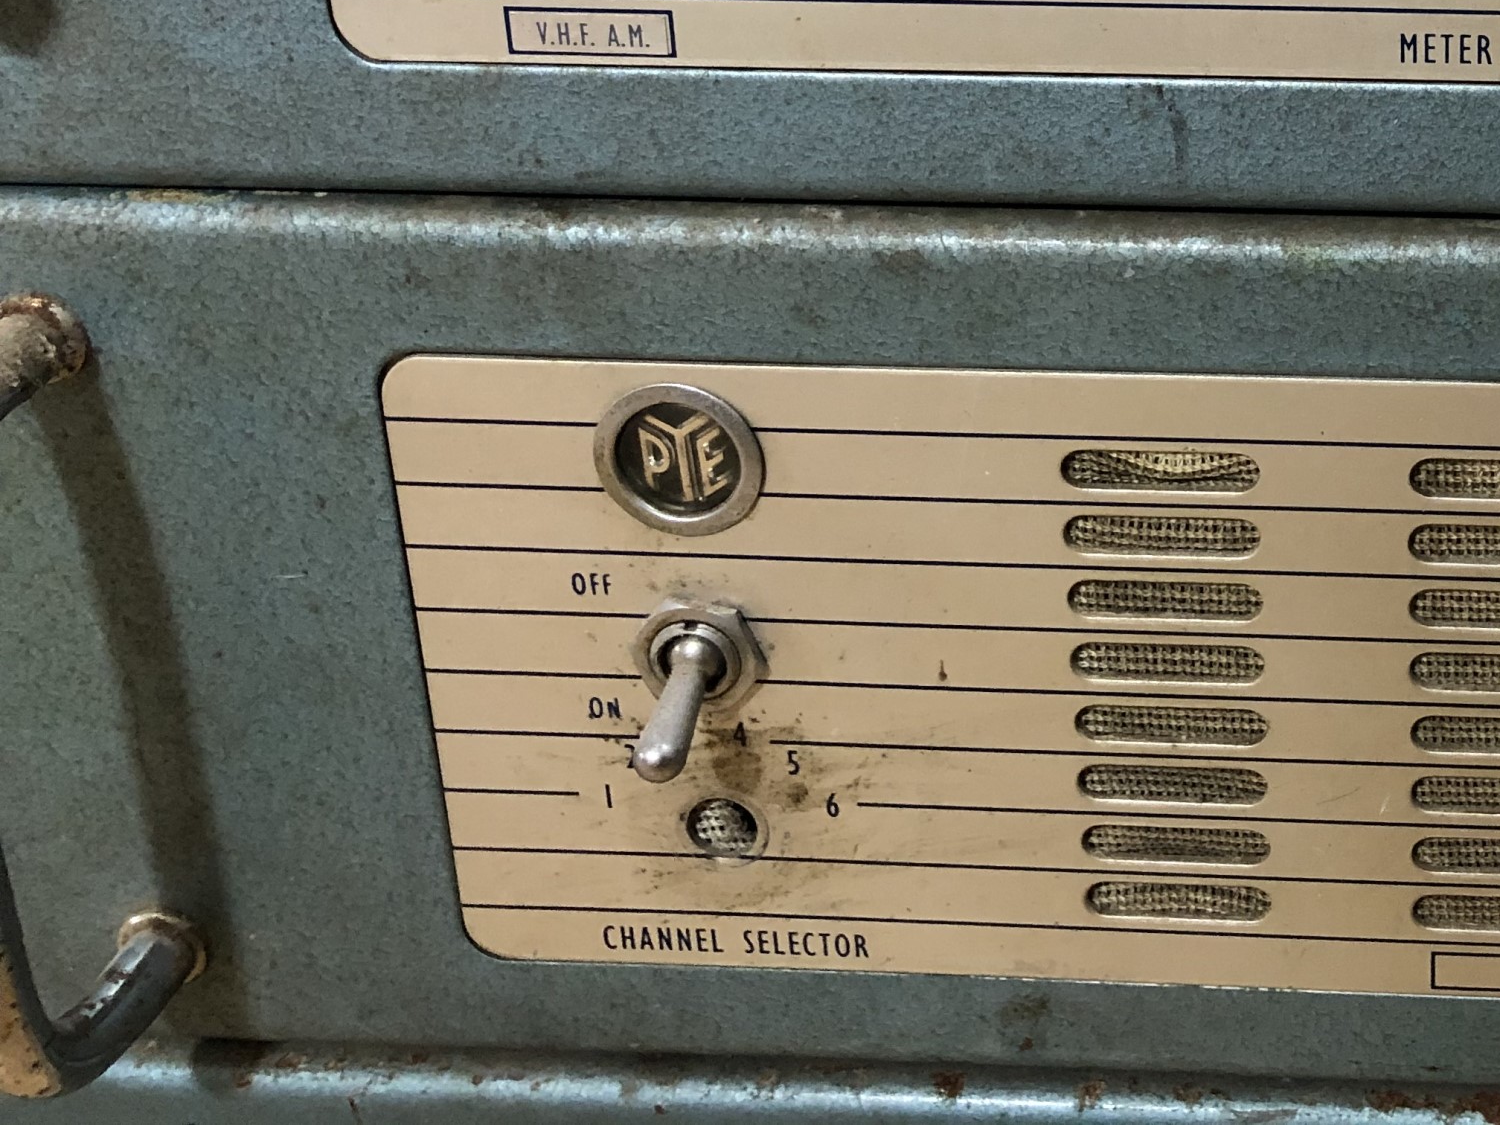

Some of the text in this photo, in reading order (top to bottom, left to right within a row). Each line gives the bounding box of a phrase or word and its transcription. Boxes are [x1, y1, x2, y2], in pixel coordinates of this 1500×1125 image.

[536, 21, 651, 48] V.H.F. A.M.
[1400, 32, 1493, 65] METER
[637, 411, 729, 503] PYE
[571, 573, 612, 596] OFF
[588, 696, 622, 719] ON
[733, 721, 747, 747] 4
[787, 749, 800, 776] 5
[605, 783, 613, 809] 1
[825, 792, 839, 818] 6
[603, 925, 870, 958] CHANNEL SELECTOR
